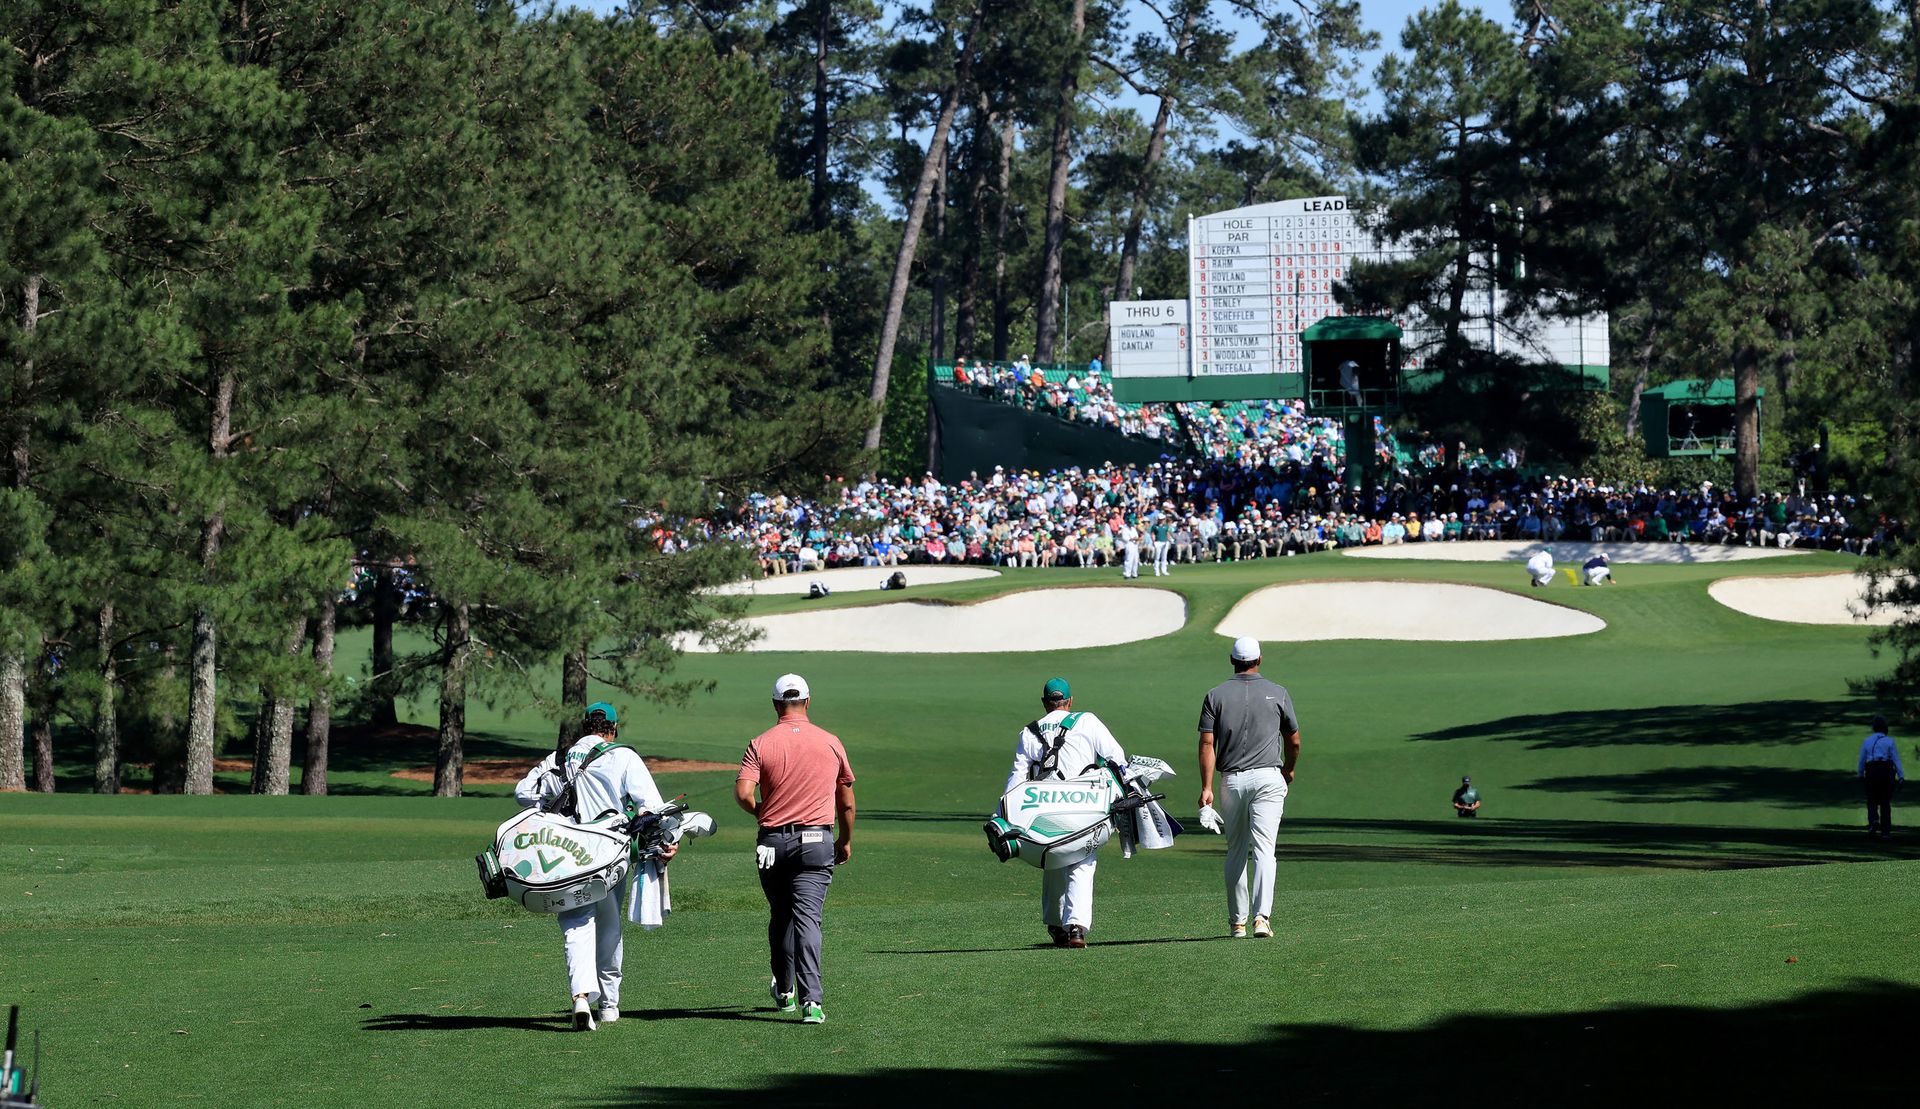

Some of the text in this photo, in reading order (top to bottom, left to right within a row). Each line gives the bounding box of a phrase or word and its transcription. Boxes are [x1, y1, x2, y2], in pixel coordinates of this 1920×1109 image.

[1304, 200, 1354, 212] LEADE
[1223, 220, 1253, 229] HOLE
[1286, 218, 1291, 228] 2
[1298, 218, 1303, 227] 3
[1310, 217, 1315, 226] 4
[1322, 217, 1327, 226] 5
[1334, 216, 1339, 226] 6
[1345, 216, 1350, 225] 7
[1228, 232, 1249, 241] PAR
[1274, 231, 1279, 240] 4
[1286, 231, 1292, 240] 5
[1297, 231, 1303, 239] 4
[1310, 230, 1315, 240] 3
[1322, 230, 1327, 239] 4
[1334, 229, 1339, 239] 3
[1345, 229, 1351, 238] 4
[1212, 245, 1240, 256] KOEPKA
[1334, 242, 1340, 252] 9
[1212, 259, 1233, 268] RAHM
[1275, 257, 1280, 266] 9
[1287, 257, 1292, 266] 9
[1212, 272, 1245, 281] HOVLAND
[1335, 268, 1341, 278] 6
[1213, 285, 1245, 294] CANTLAY
[1213, 298, 1241, 307] HENLEY
[1126, 306, 1175, 318] THRU 6
[1213, 311, 1254, 320] SCHEFFLER
[1121, 329, 1155, 338] HOVLAND
[1214, 324, 1238, 333] YOUNG
[1121, 341, 1153, 350] CANTLAY
[1214, 337, 1259, 347] MATSUYAMA
[1215, 350, 1256, 360] WOODLAND
[1215, 363, 1253, 373] THEEGALA
[1022, 787, 1099, 804] SRIXON
[514, 828, 594, 866] Callaway
